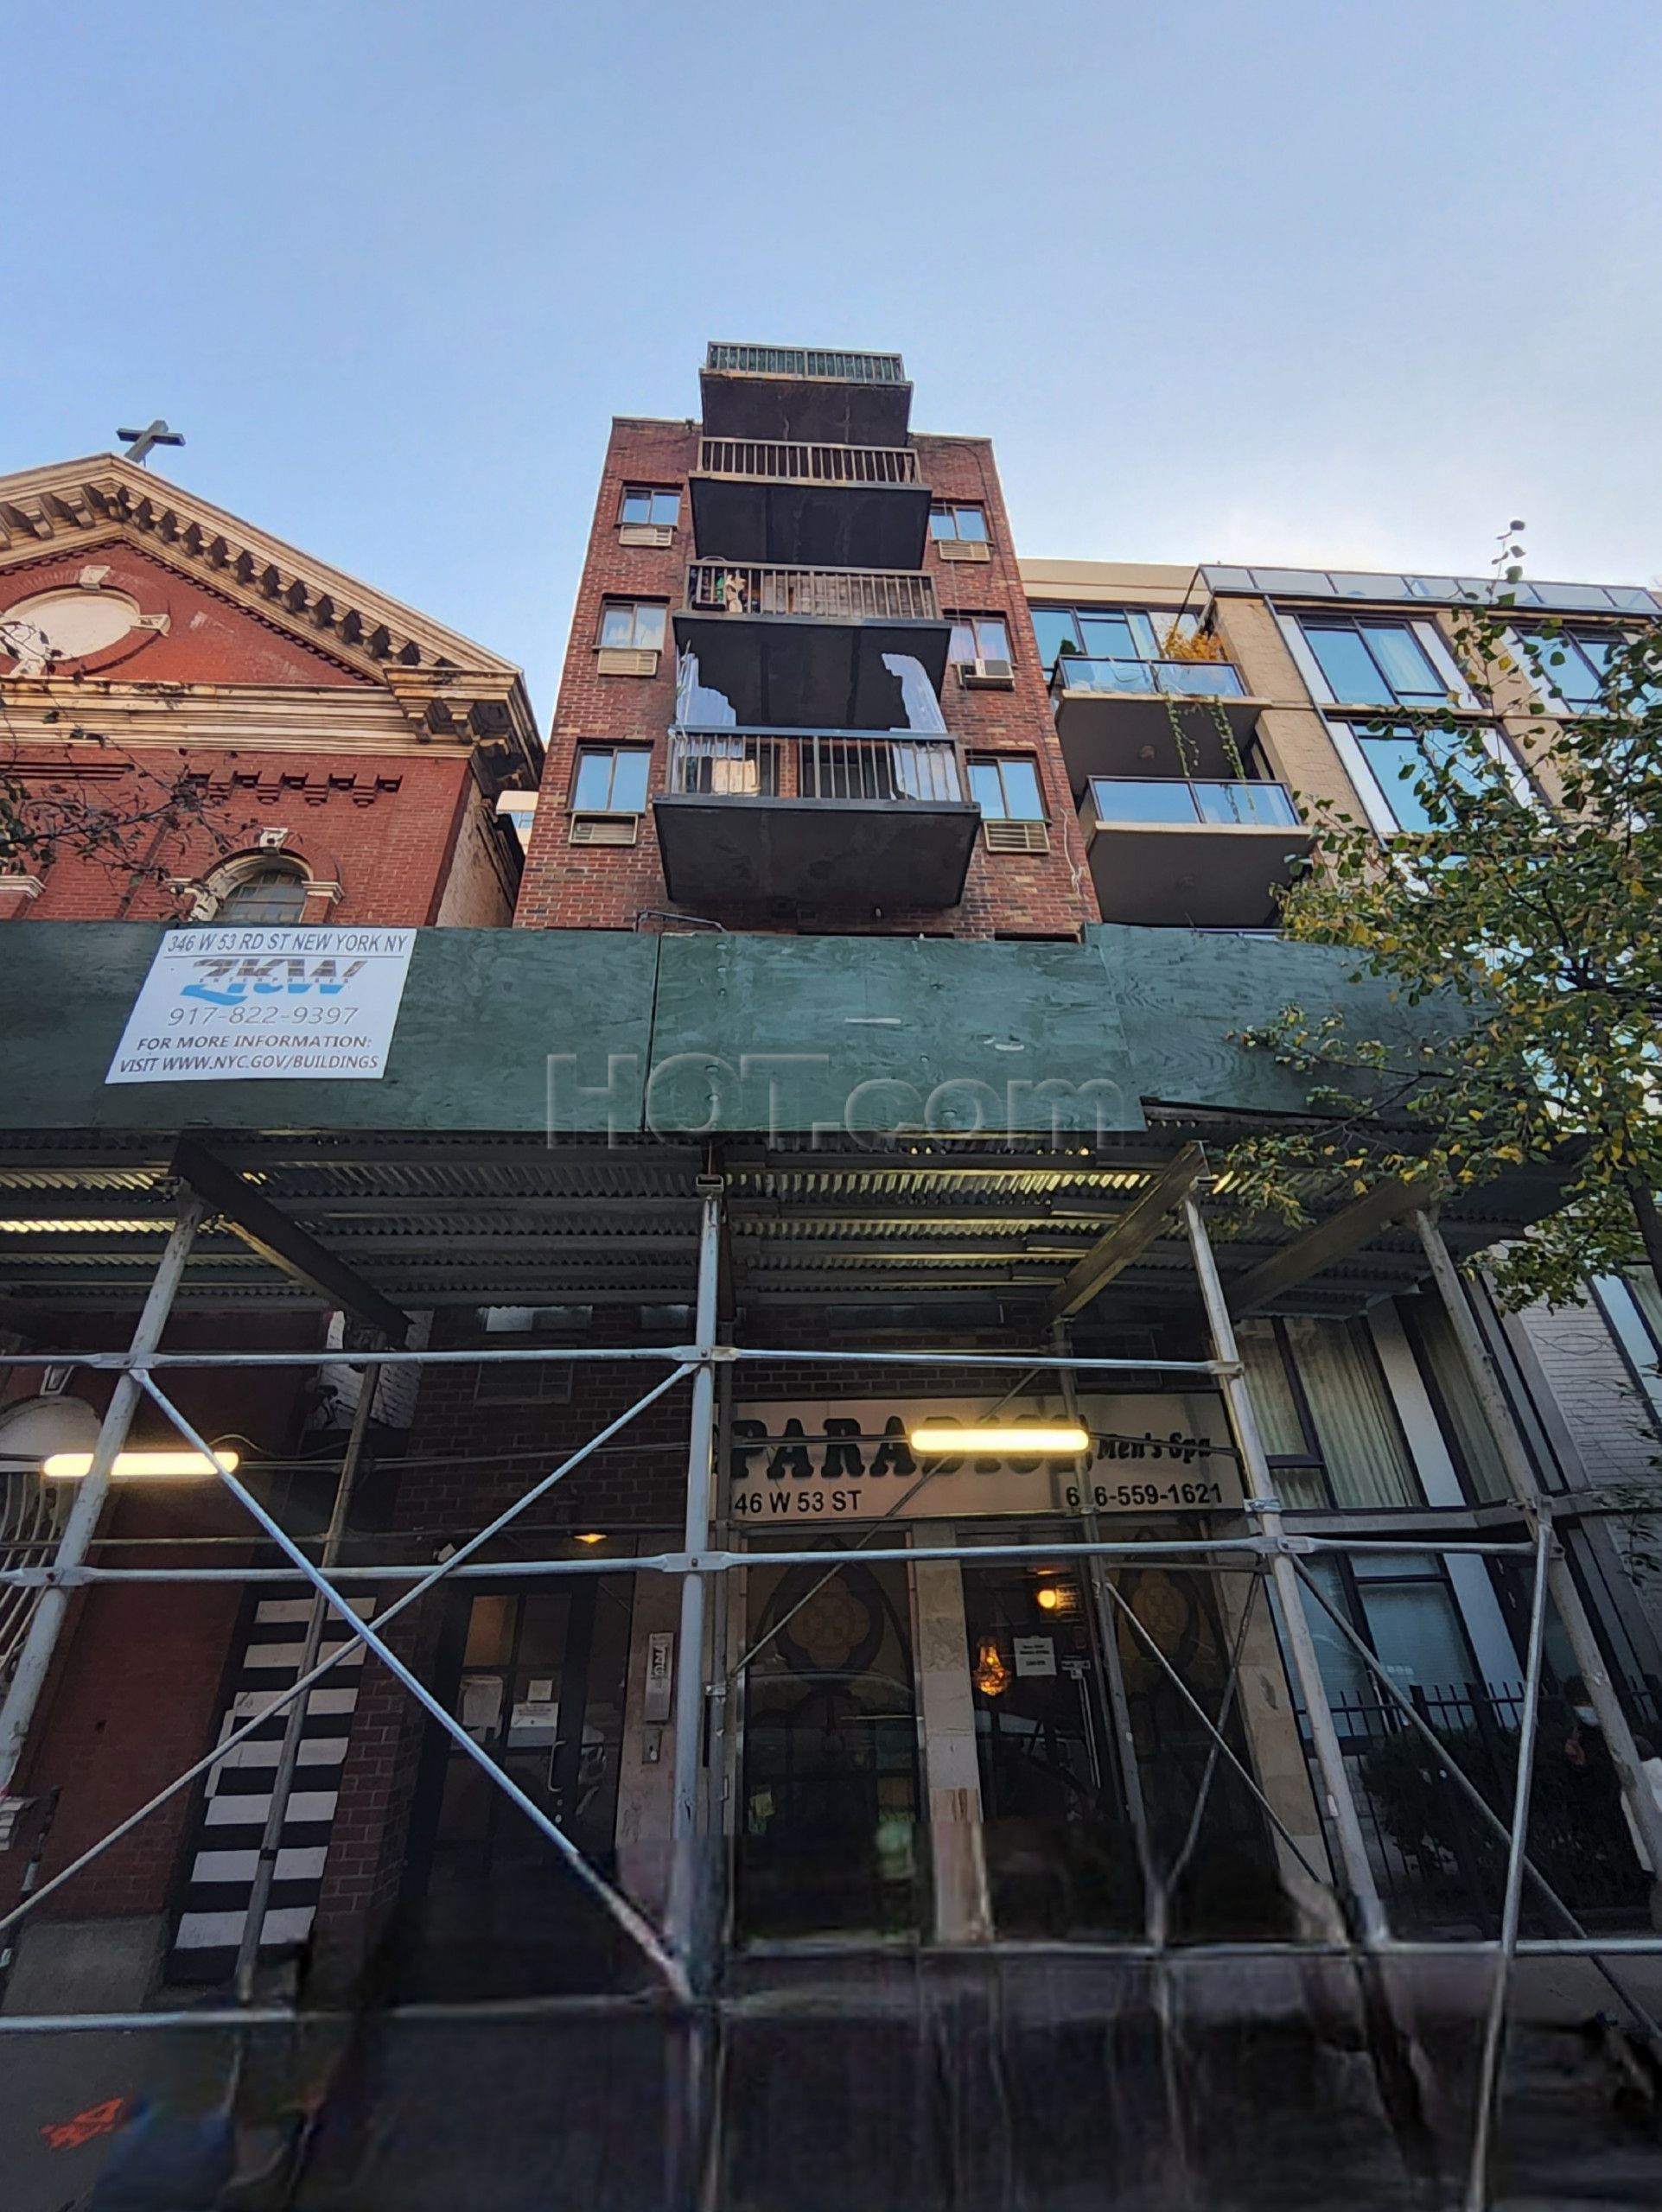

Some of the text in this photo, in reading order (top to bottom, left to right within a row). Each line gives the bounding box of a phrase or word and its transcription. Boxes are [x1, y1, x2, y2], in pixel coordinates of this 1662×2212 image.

[167, 932, 409, 952] 346 W 53 RD ST NEW YORK NY
[167, 1006, 359, 1027] 917-822-9397
[137, 1035, 372, 1052] FOR MORE INFORMATION:
[119, 1054, 379, 1073] VISIT WWW.NYC.GOV/BUILDINGS
[729, 1490, 863, 1515] 46 W 53 ST
[1066, 1483, 1222, 1507] 66-559-1621
